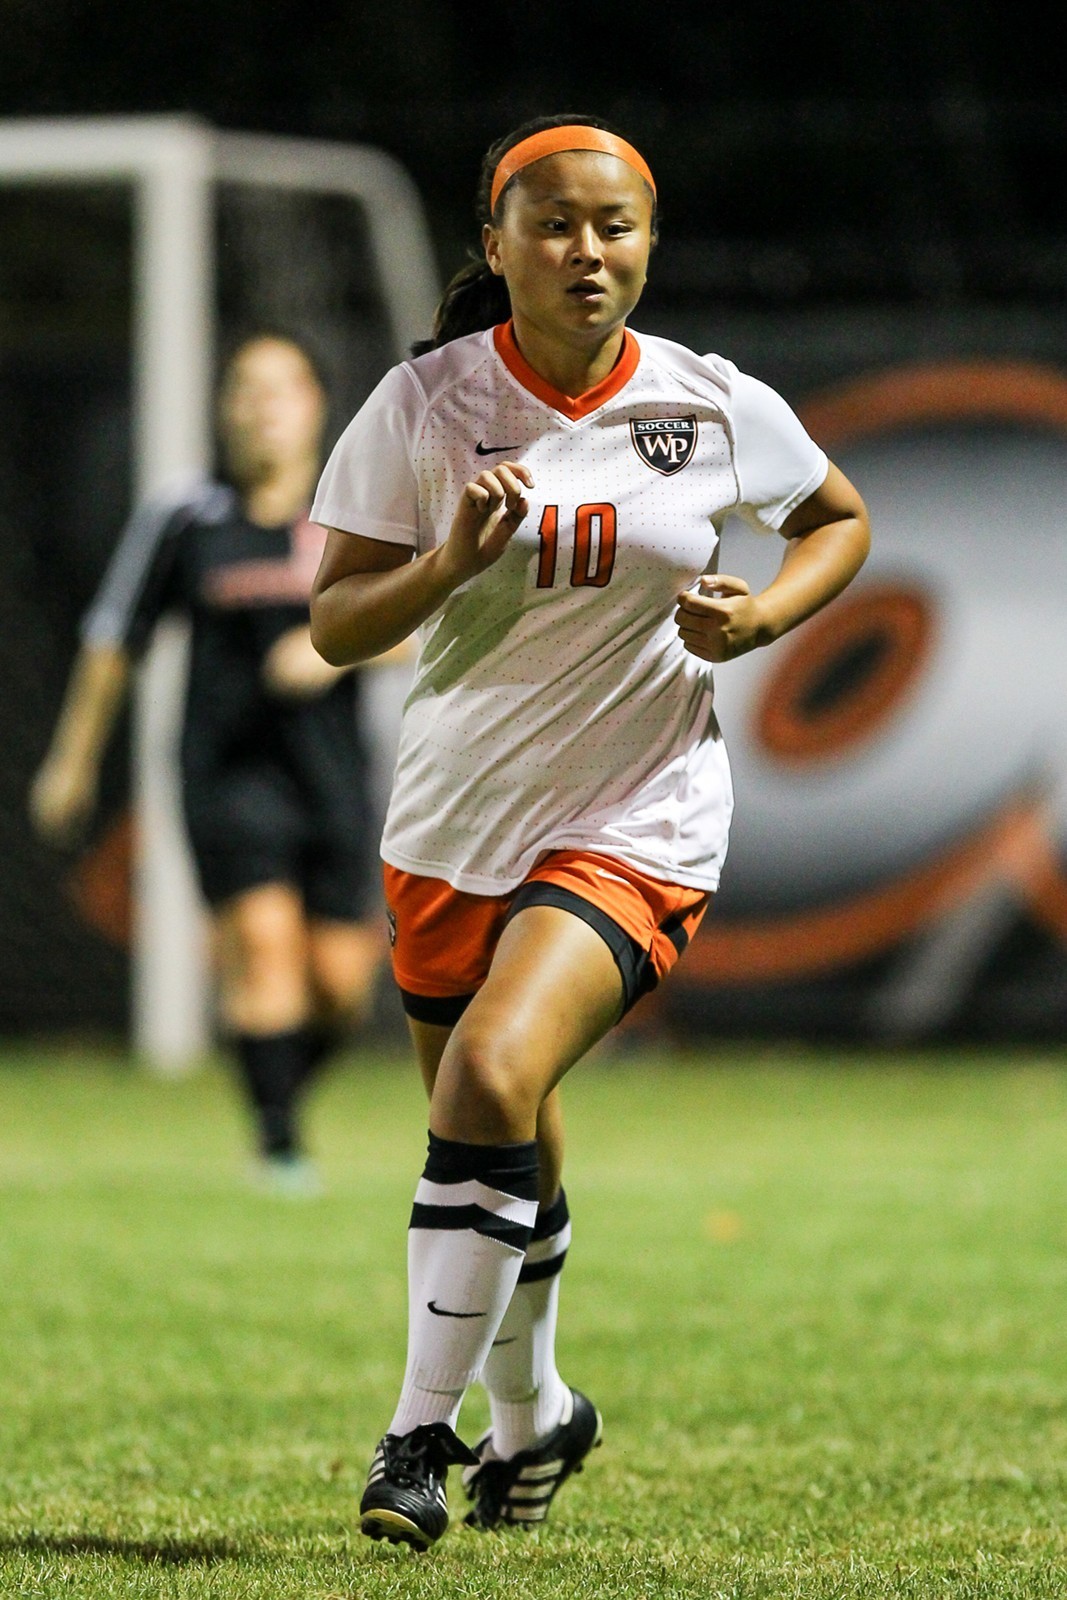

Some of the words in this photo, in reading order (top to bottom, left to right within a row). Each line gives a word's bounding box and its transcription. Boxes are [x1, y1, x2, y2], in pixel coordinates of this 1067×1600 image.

[637, 421, 690, 431] SOCCER
[642, 434, 688, 463] WP
[536, 502, 617, 588] 10
